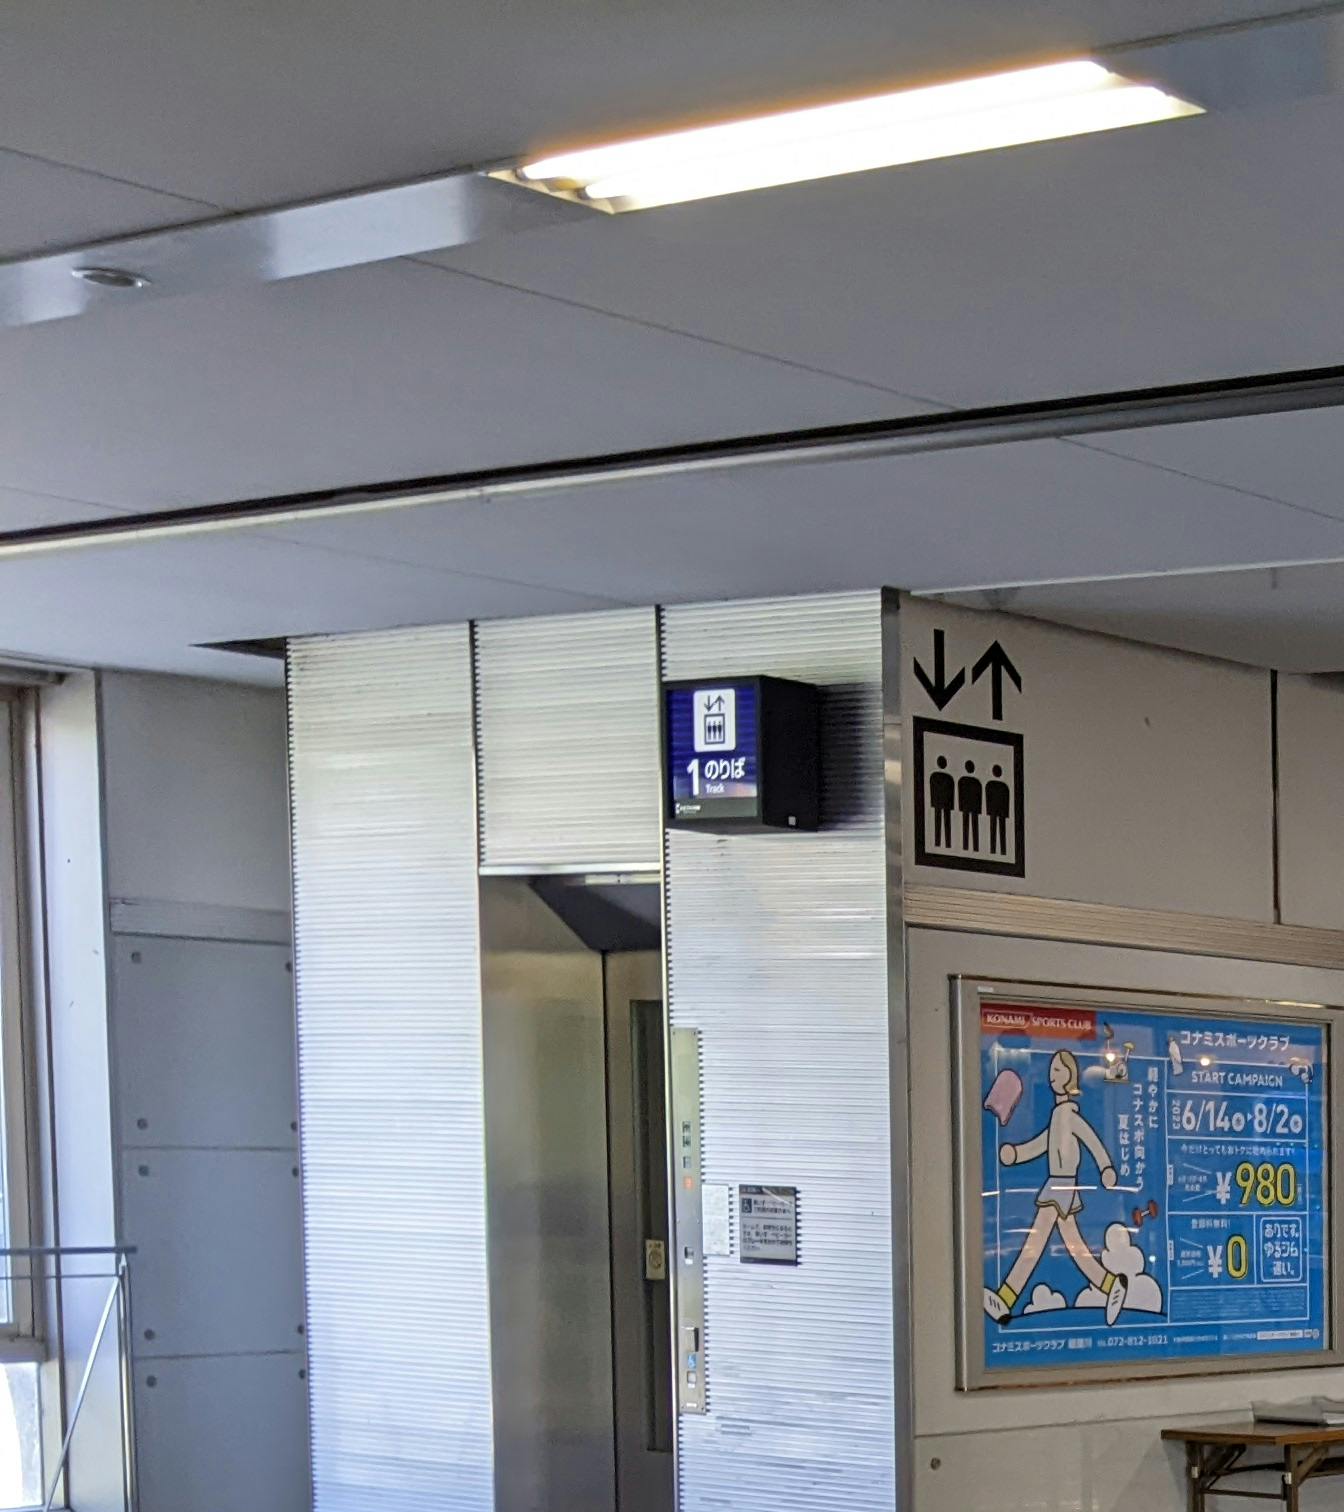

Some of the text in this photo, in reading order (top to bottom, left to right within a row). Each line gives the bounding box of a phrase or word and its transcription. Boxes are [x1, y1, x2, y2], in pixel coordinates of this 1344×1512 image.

[687, 756, 746, 796] 1 のりば
[986, 1014, 1092, 1030] KONAMI SPORTS CLUB
[1180, 1030, 1290, 1051] コナミスポーツクラブ
[1191, 1071, 1283, 1087] START CAMPAIGN
